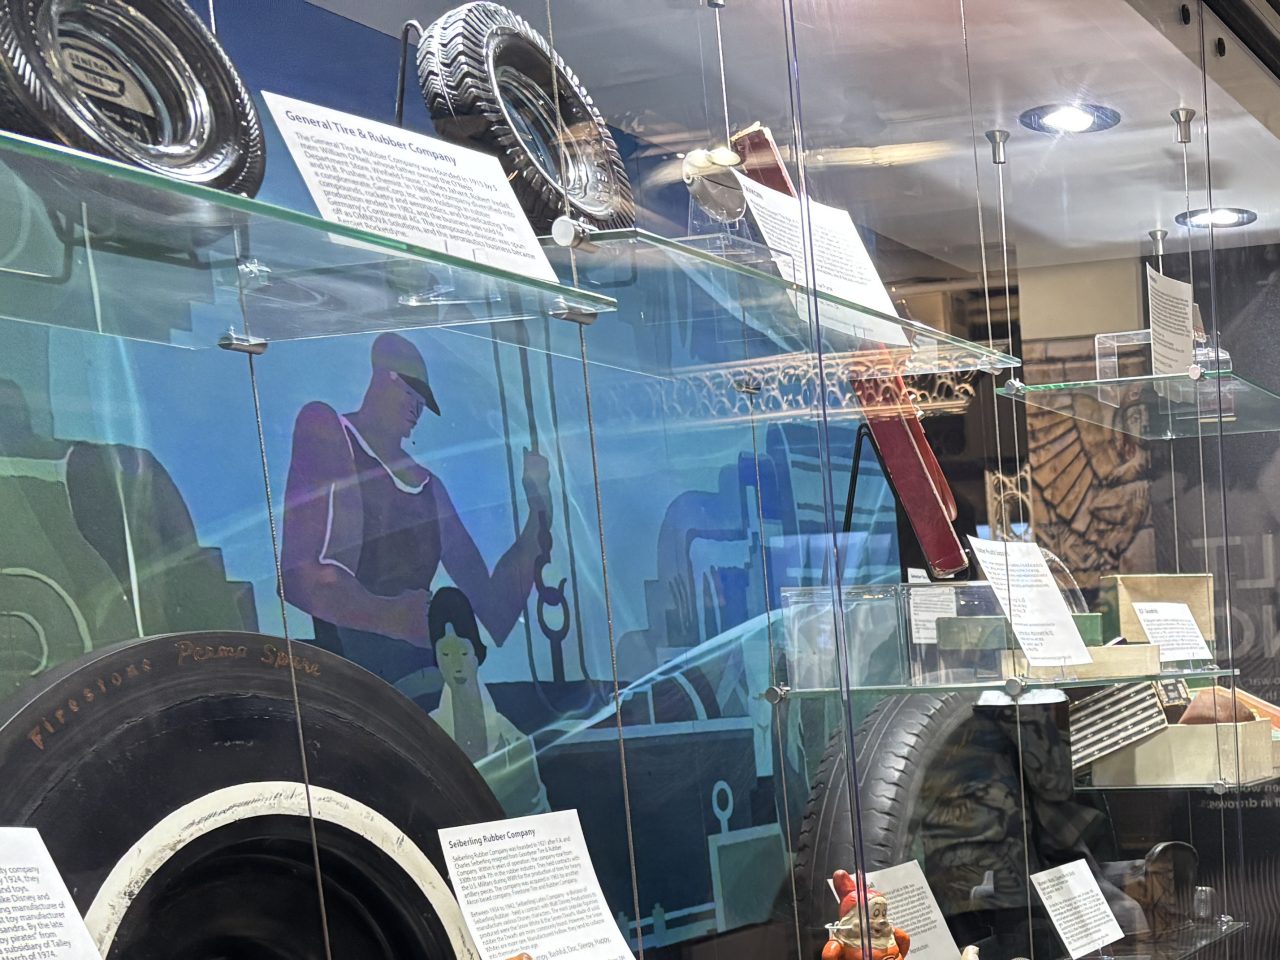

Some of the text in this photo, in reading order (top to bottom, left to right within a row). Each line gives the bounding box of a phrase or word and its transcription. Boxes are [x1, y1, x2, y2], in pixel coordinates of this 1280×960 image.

[285, 110, 457, 165] General Tire & Rubber Company
[448, 829, 536, 849] Seiberling Rubber Company
